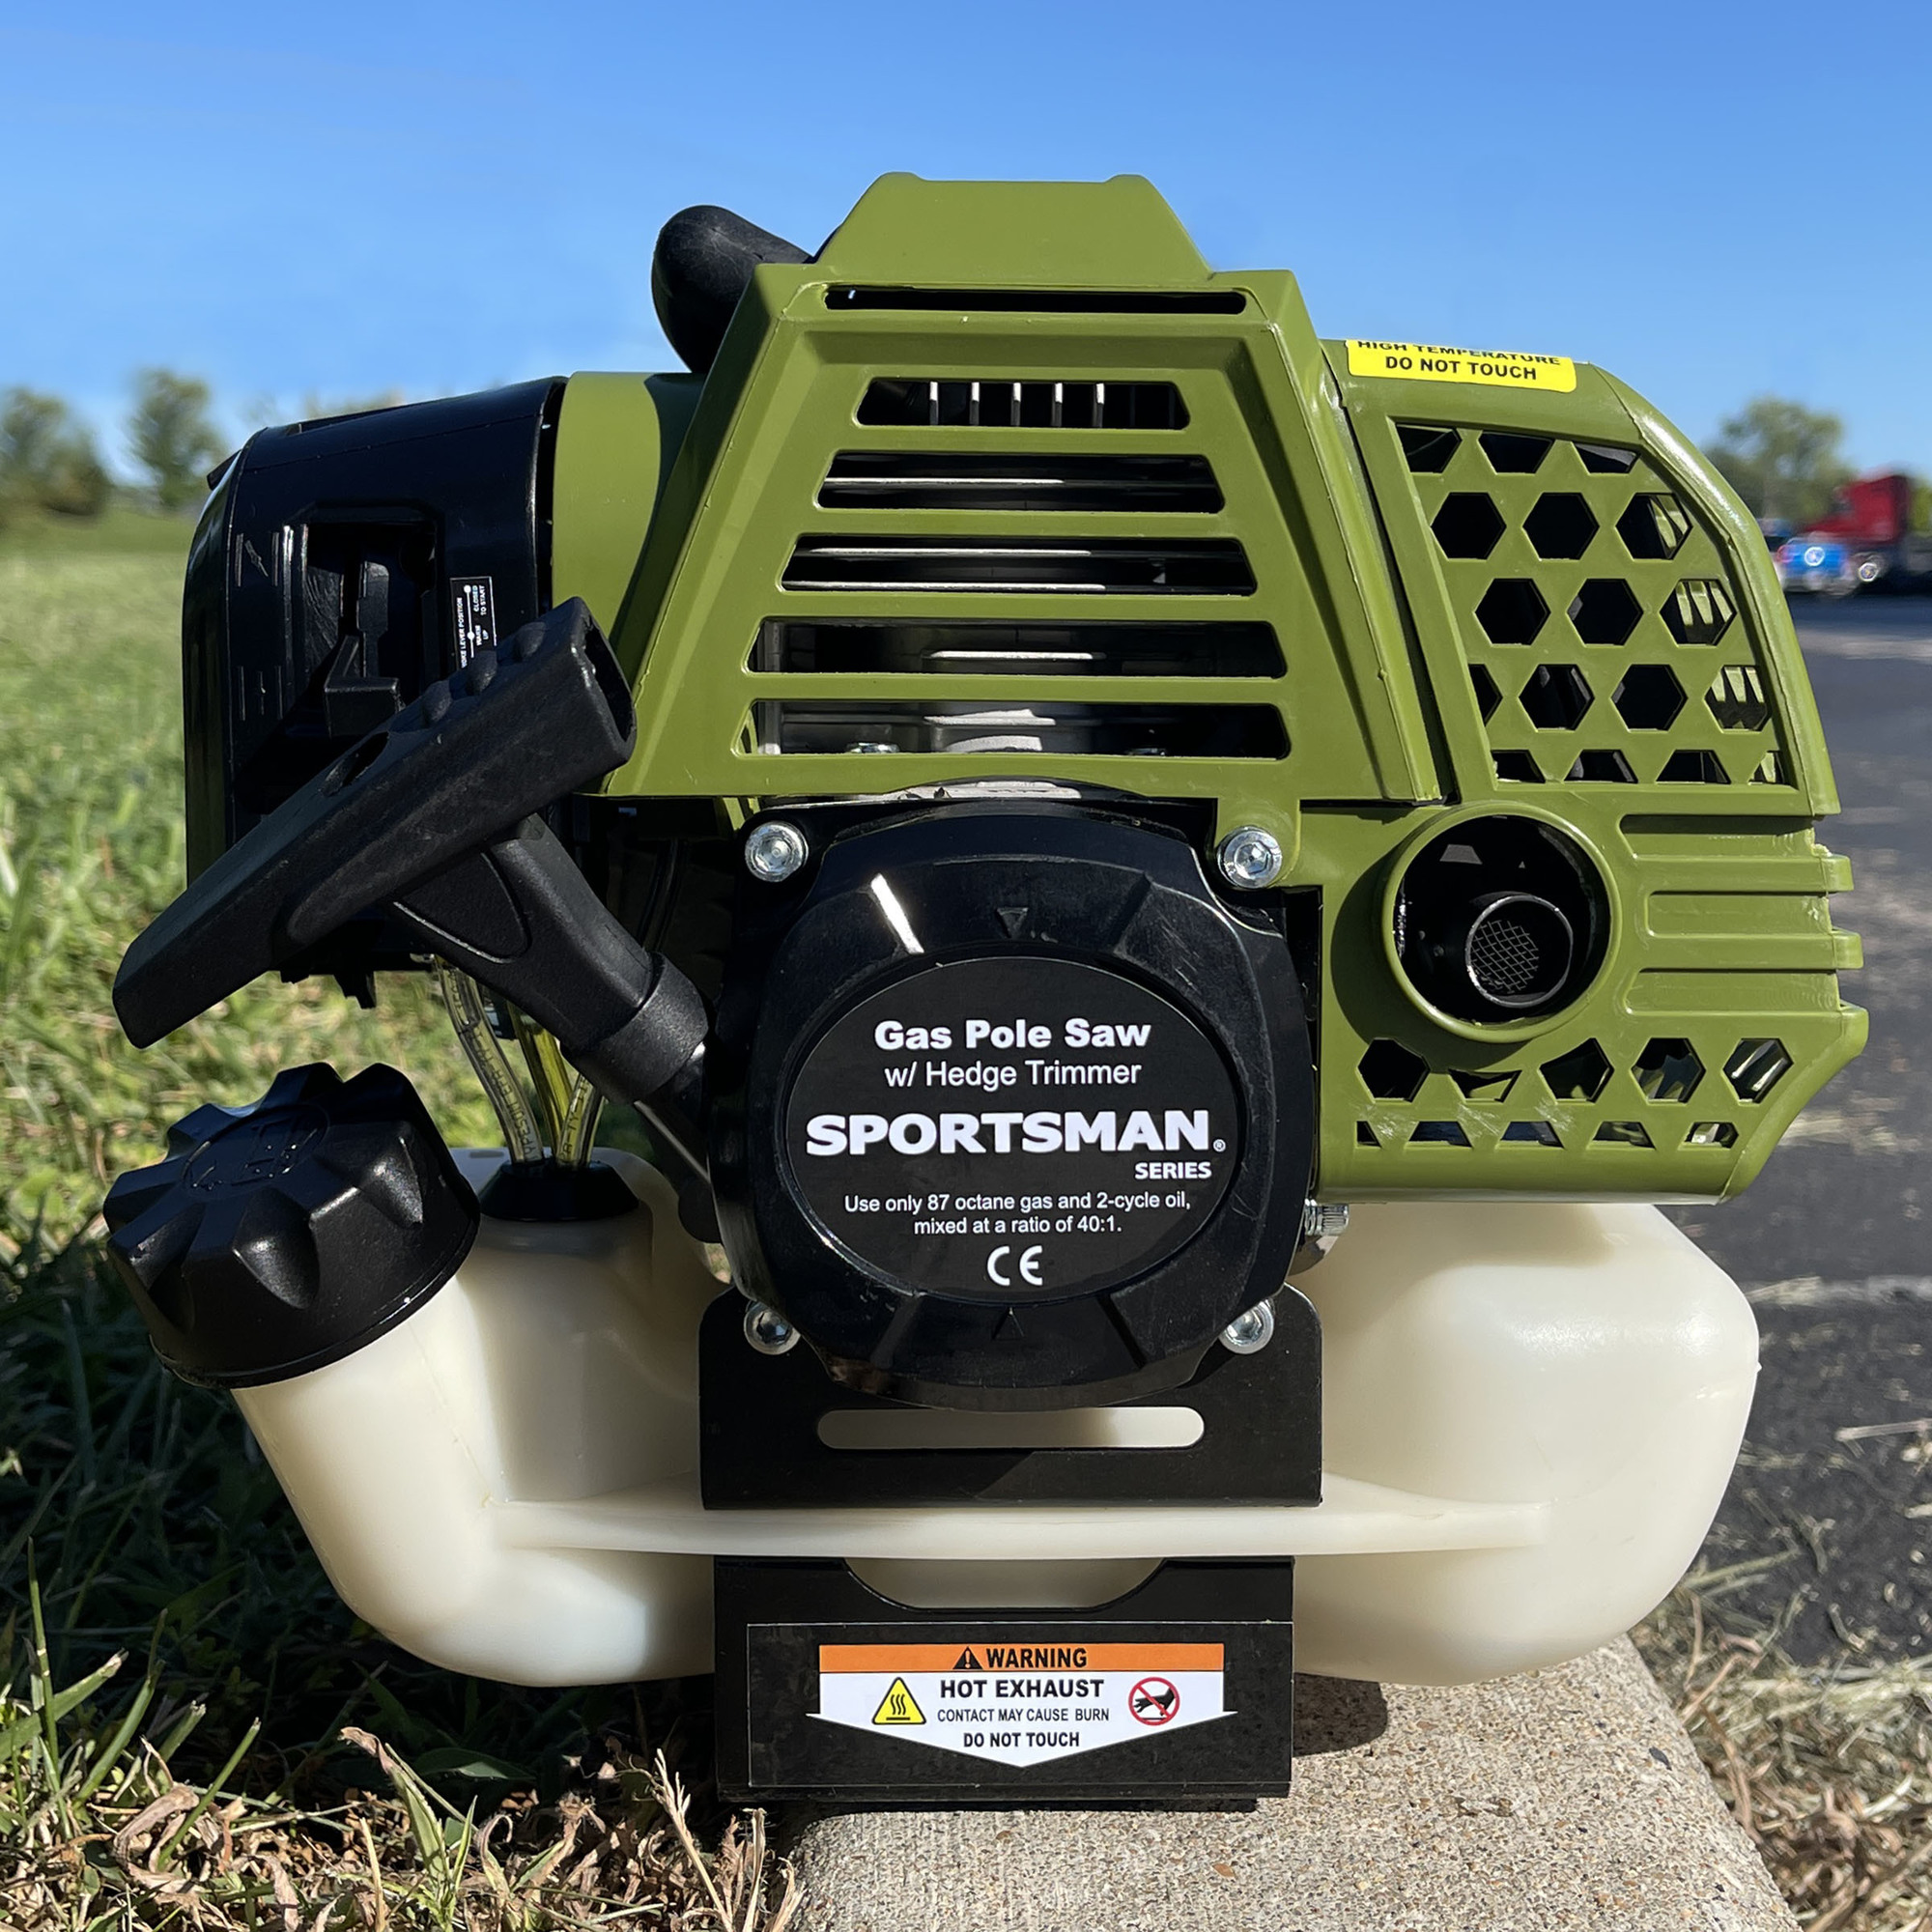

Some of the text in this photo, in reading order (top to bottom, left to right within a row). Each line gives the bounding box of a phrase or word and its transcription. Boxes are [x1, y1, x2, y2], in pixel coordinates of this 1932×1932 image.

[1357, 340, 1561, 365] HIGH TEMPERATURE
[1385, 355, 1537, 381] DO NOT TOUCH
[874, 1017, 1151, 1050] Gas Pole Saw
[884, 1060, 1142, 1093] w/ Hedge Trimmer
[1134, 1161, 1212, 1179] SERIES
[844, 1190, 1191, 1215] Use only 87 octane gas and 2-cycle oil,
[912, 1214, 1122, 1235] mixed at a ratio of 40:1.
[987, 1245, 1043, 1286] CE
[985, 1647, 1088, 1668] WARNING
[940, 1679, 1104, 1698] HOT EXHAUST
[937, 1708, 1110, 1722] CONTACT MAY CAUSE BURN
[963, 1731, 1080, 1747] DO NOT TOUCH
